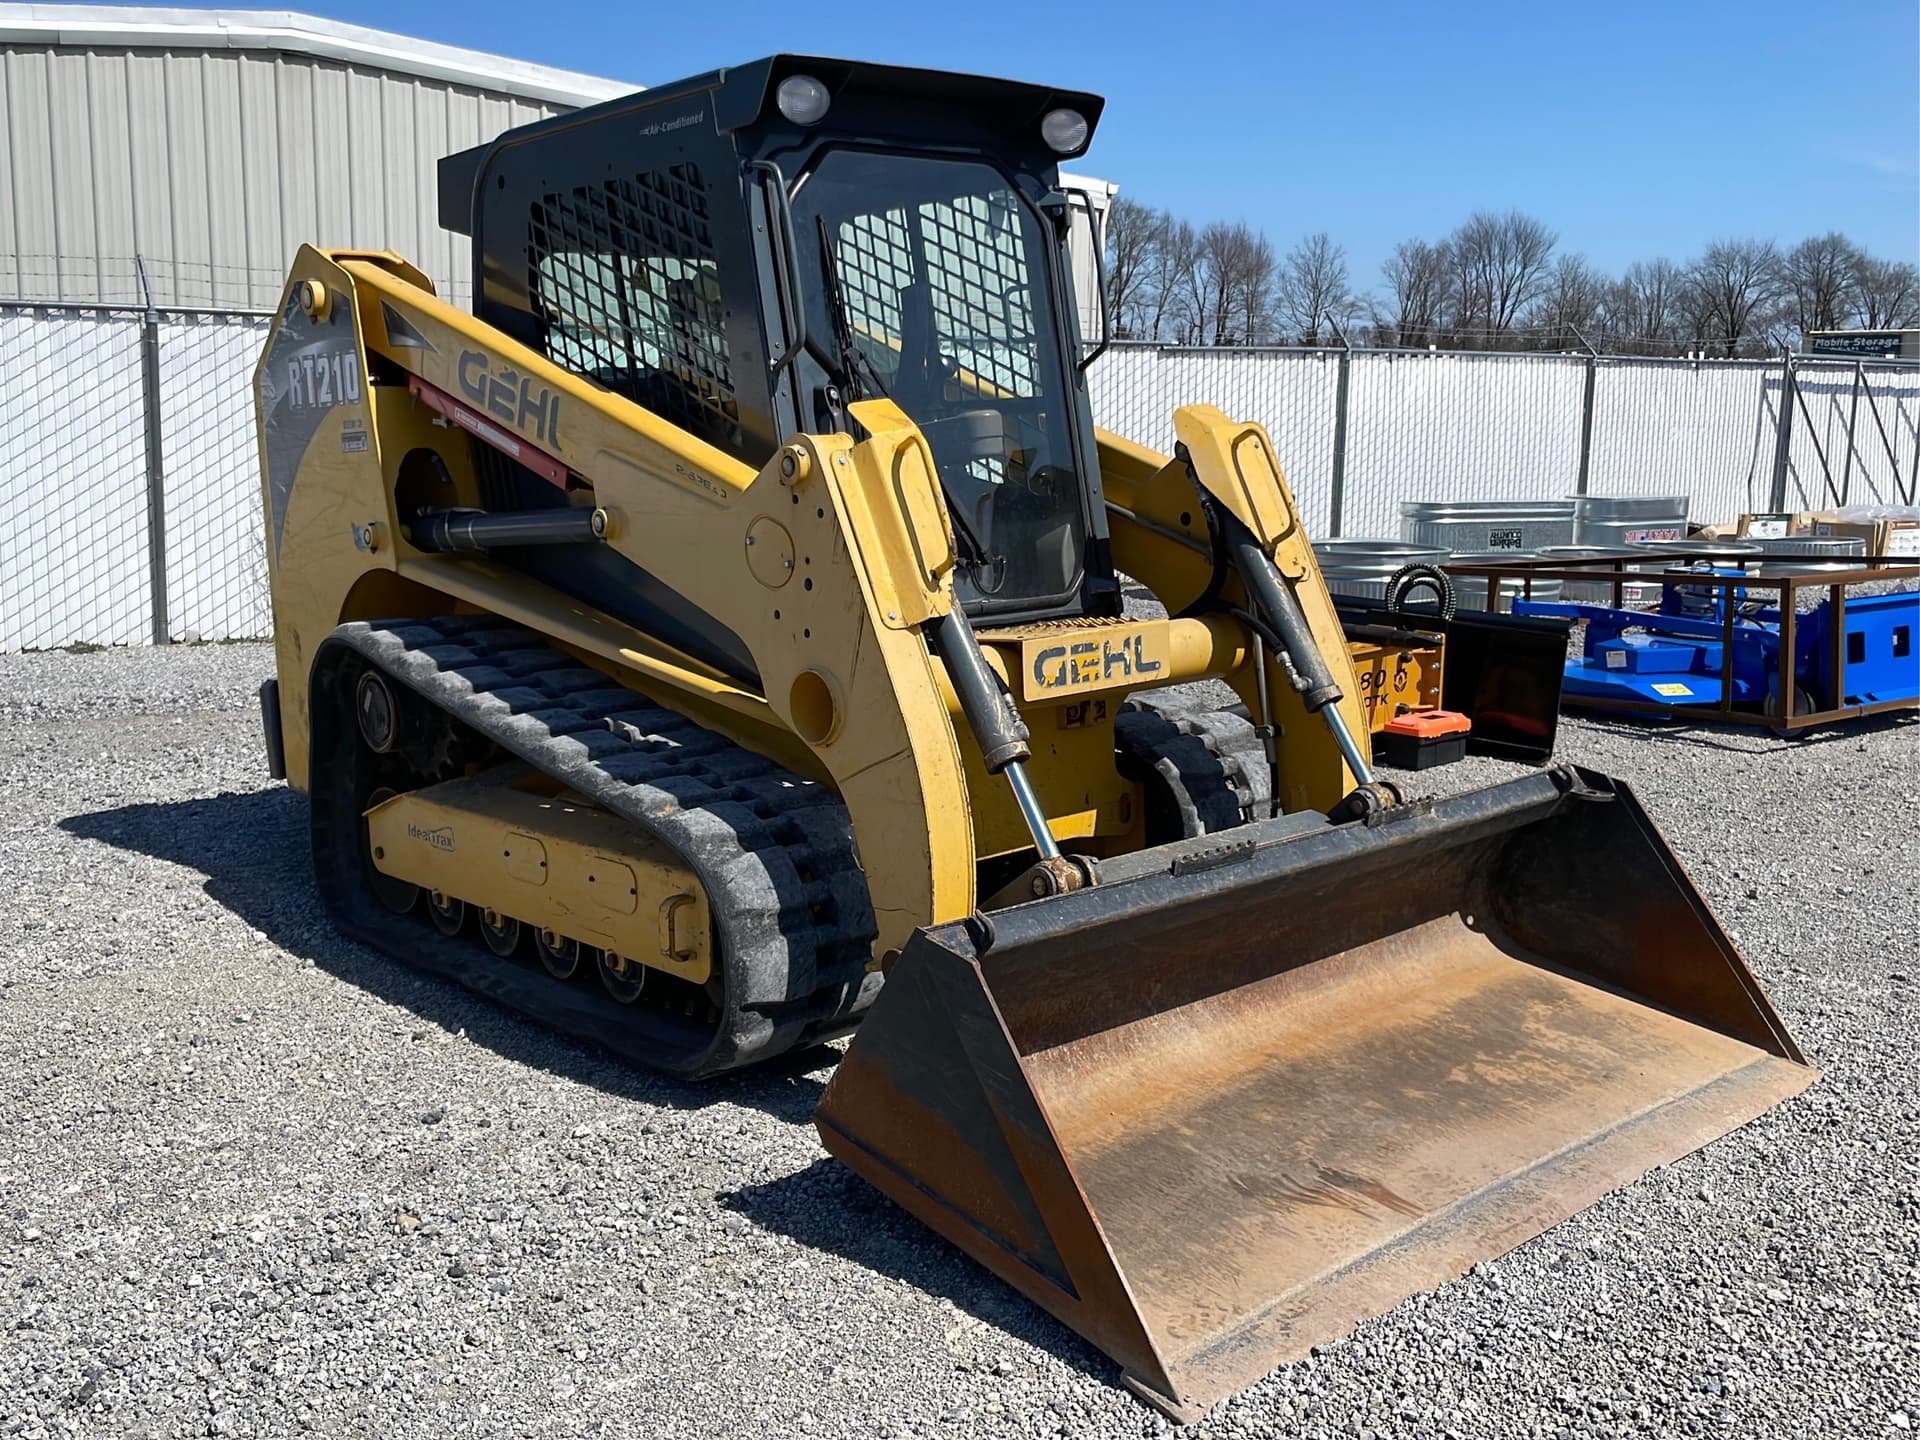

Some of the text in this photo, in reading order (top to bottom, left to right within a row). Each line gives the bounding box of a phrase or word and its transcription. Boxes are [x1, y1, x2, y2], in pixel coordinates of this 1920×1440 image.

[1815, 338, 1850, 347] Mobile
[1852, 337, 1900, 348] Storage
[287, 350, 361, 410] RT210
[458, 350, 562, 452] GEHL
[1490, 530, 1522, 539] COUNTRY
[1490, 538, 1522, 549] Behlen
[1034, 635, 1161, 688] GEHL
